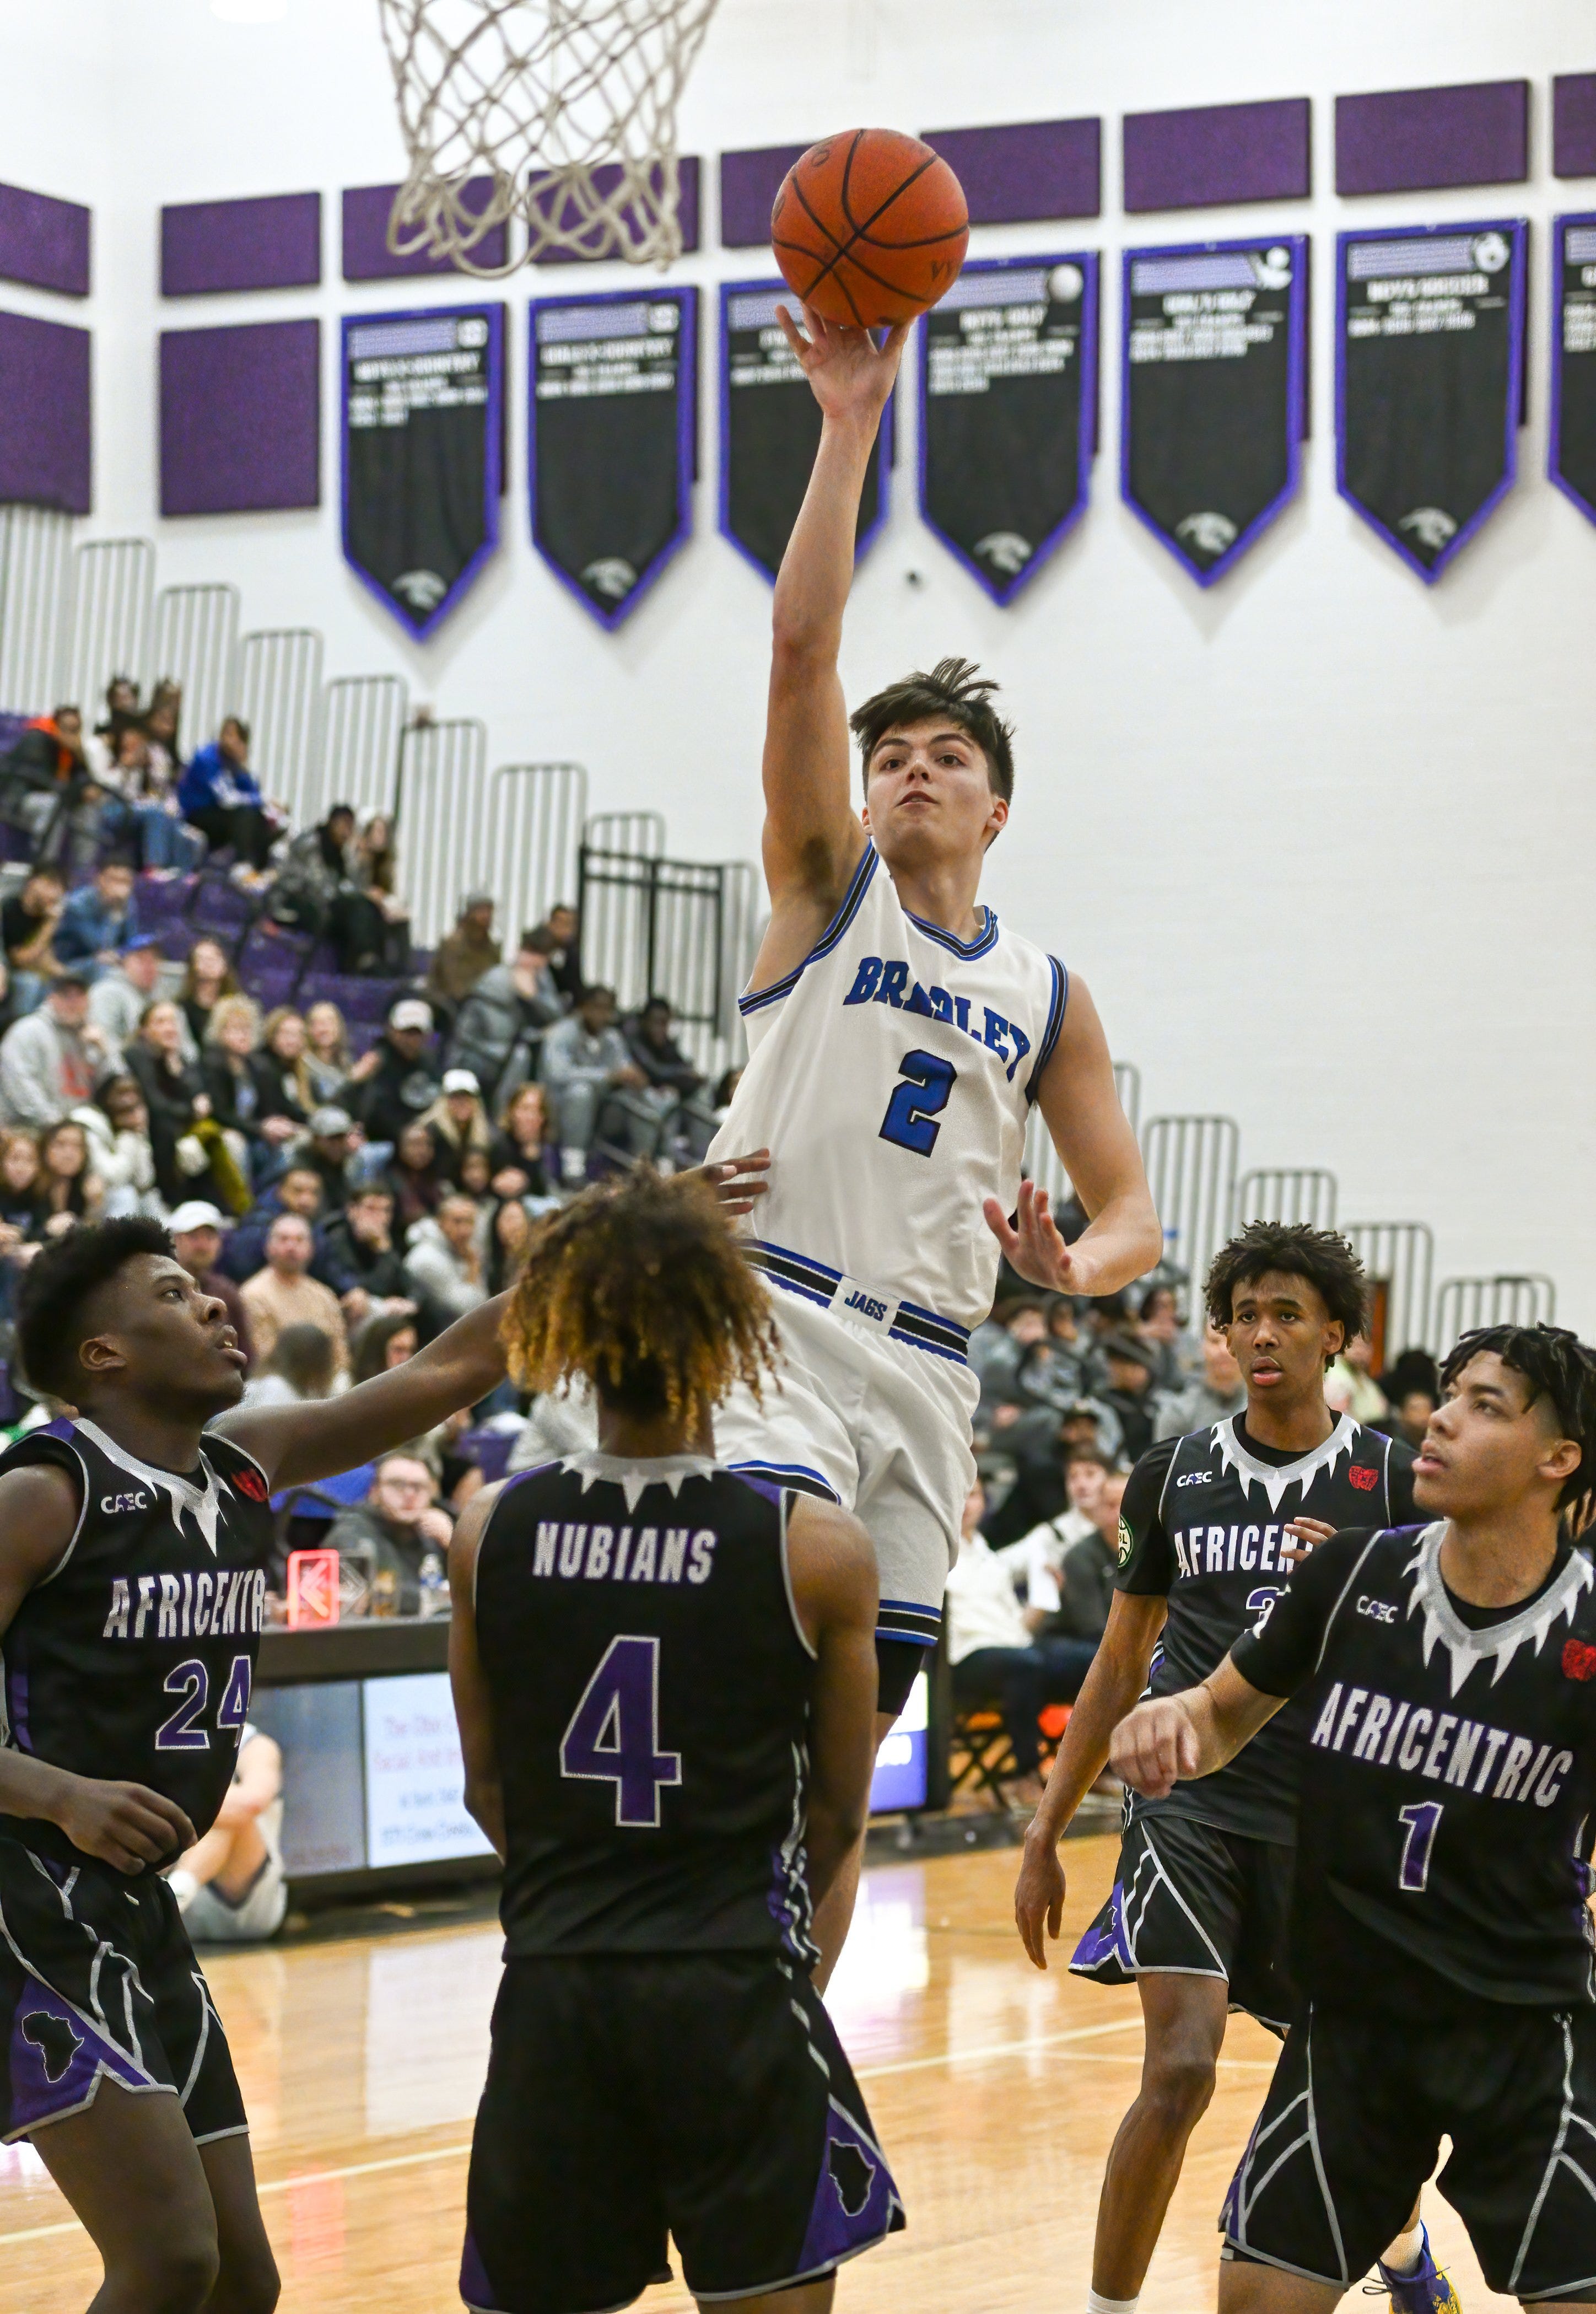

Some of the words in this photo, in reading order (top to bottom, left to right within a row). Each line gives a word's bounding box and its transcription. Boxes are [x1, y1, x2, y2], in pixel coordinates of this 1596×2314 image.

[843, 957, 1031, 1083] BRADLEY
[878, 1049, 958, 1158] 2
[844, 1290, 888, 1322] JAGS
[532, 1521, 717, 1584] NUBIANS
[1174, 1524, 1313, 1579] AFRICEN
[103, 1569, 266, 1638] AFRICENTR
[155, 1655, 252, 1750] 24
[559, 1634, 683, 1828] 4
[1311, 1682, 1574, 1808] AFRICENTRIC
[1398, 1800, 1445, 1892] 1
